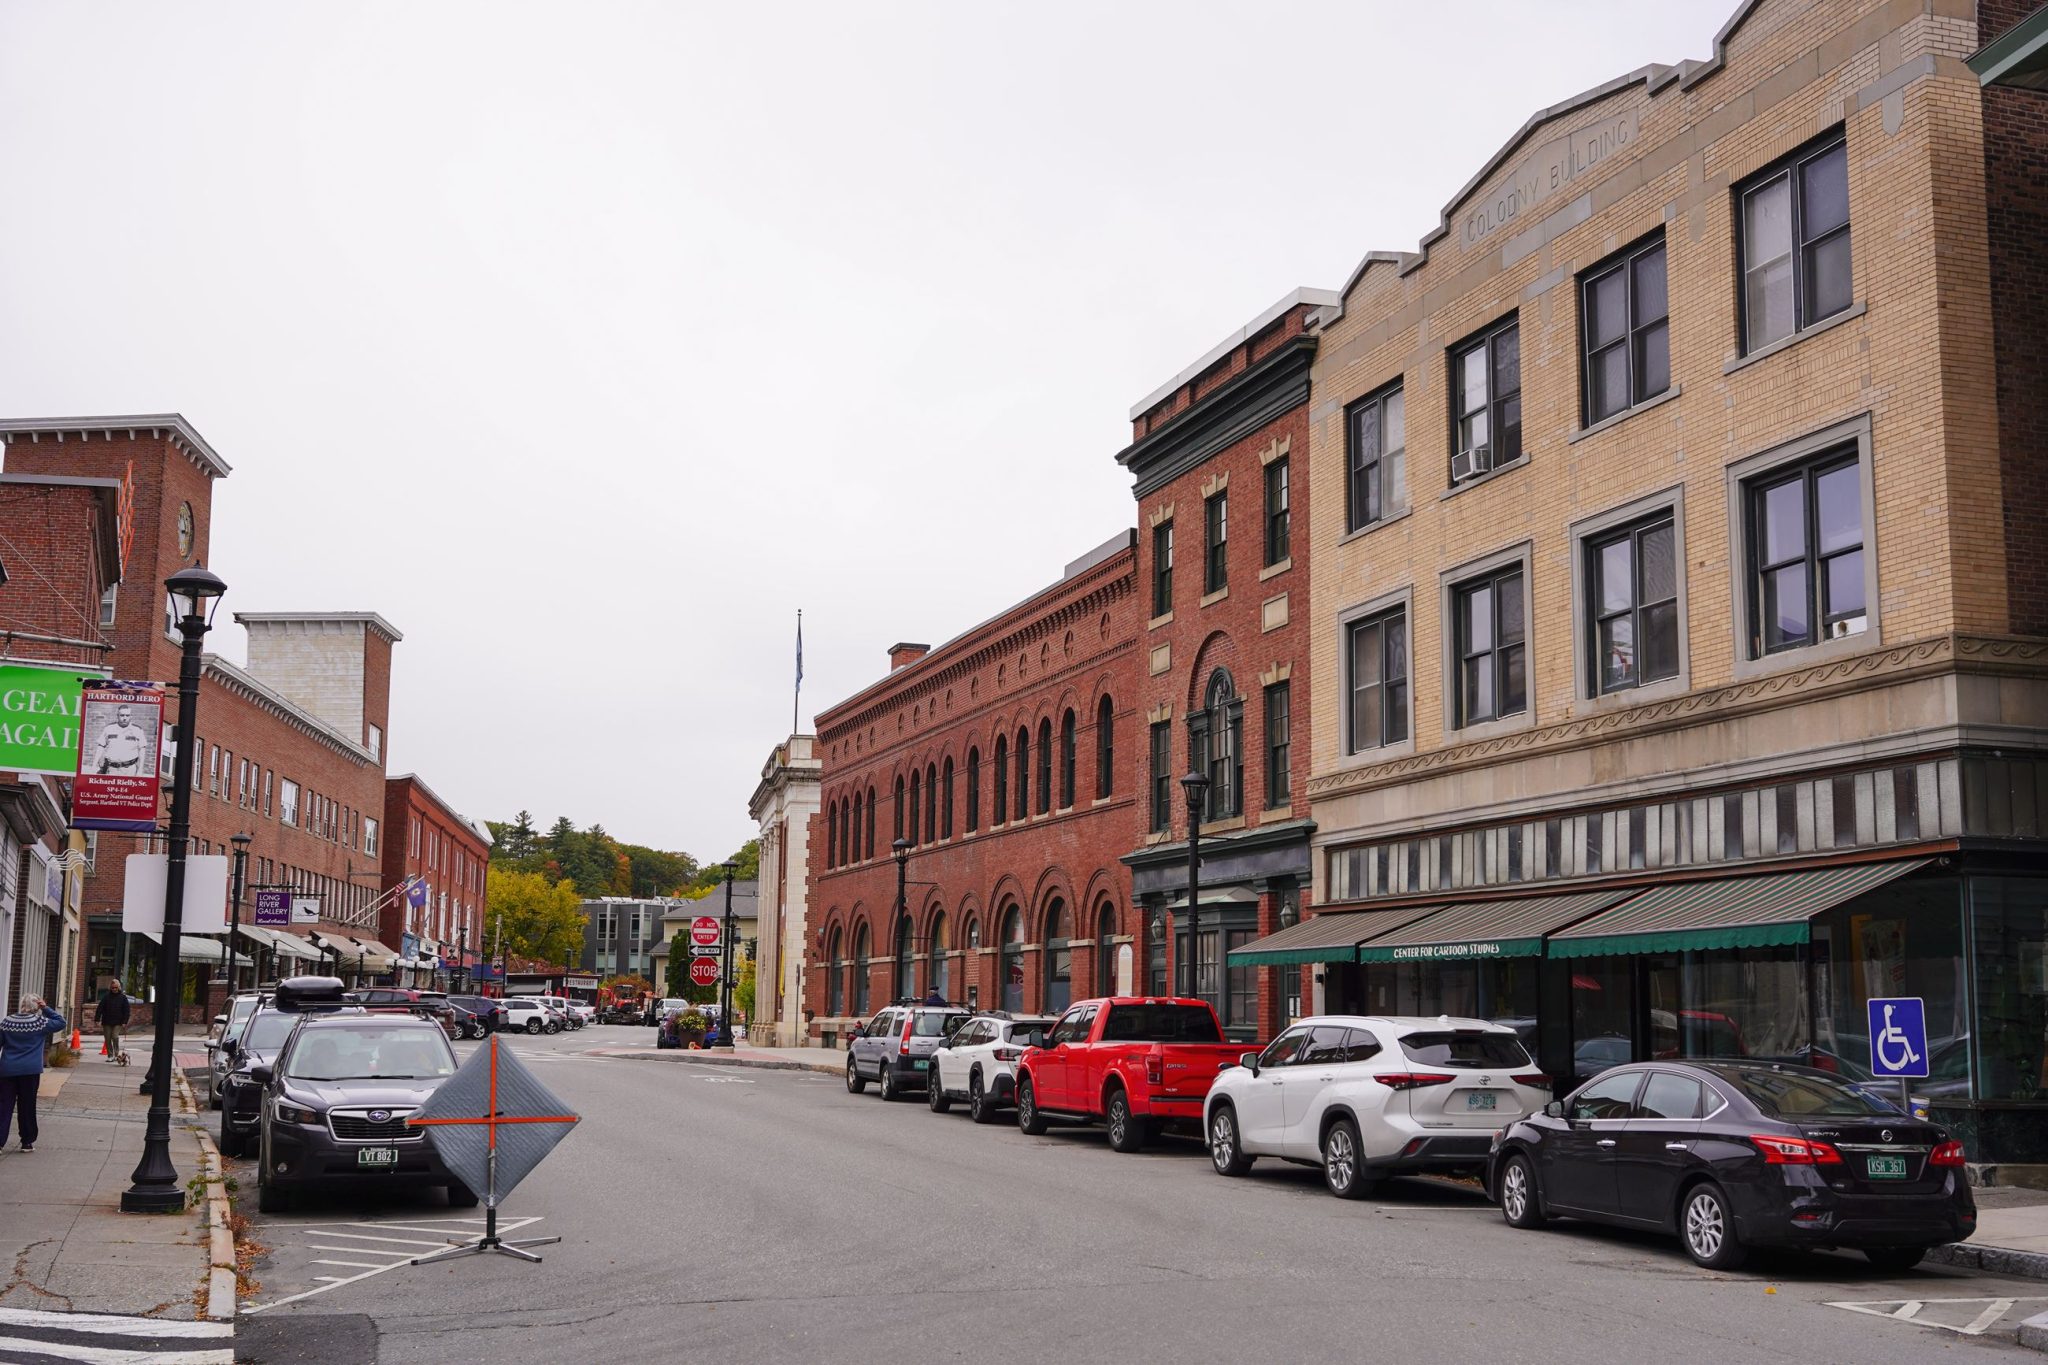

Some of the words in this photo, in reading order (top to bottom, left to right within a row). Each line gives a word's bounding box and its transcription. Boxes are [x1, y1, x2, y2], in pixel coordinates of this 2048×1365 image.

[1467, 176, 1540, 242] COLONY
[1550, 119, 1628, 190] BUILDING
[87, 692, 135, 701] HARTFORD
[88, 777, 116, 785] Richard
[116, 779, 138, 787] Rielly,
[1393, 946, 1419, 958] CENTER
[1420, 946, 1433, 957] FOR
[1433, 945, 1468, 957] CARTOON
[1469, 943, 1500, 955] STUDIES
[692, 965, 717, 977] STOP
[365, 1151, 376, 1161] VT
[377, 1151, 392, 1161] 802
